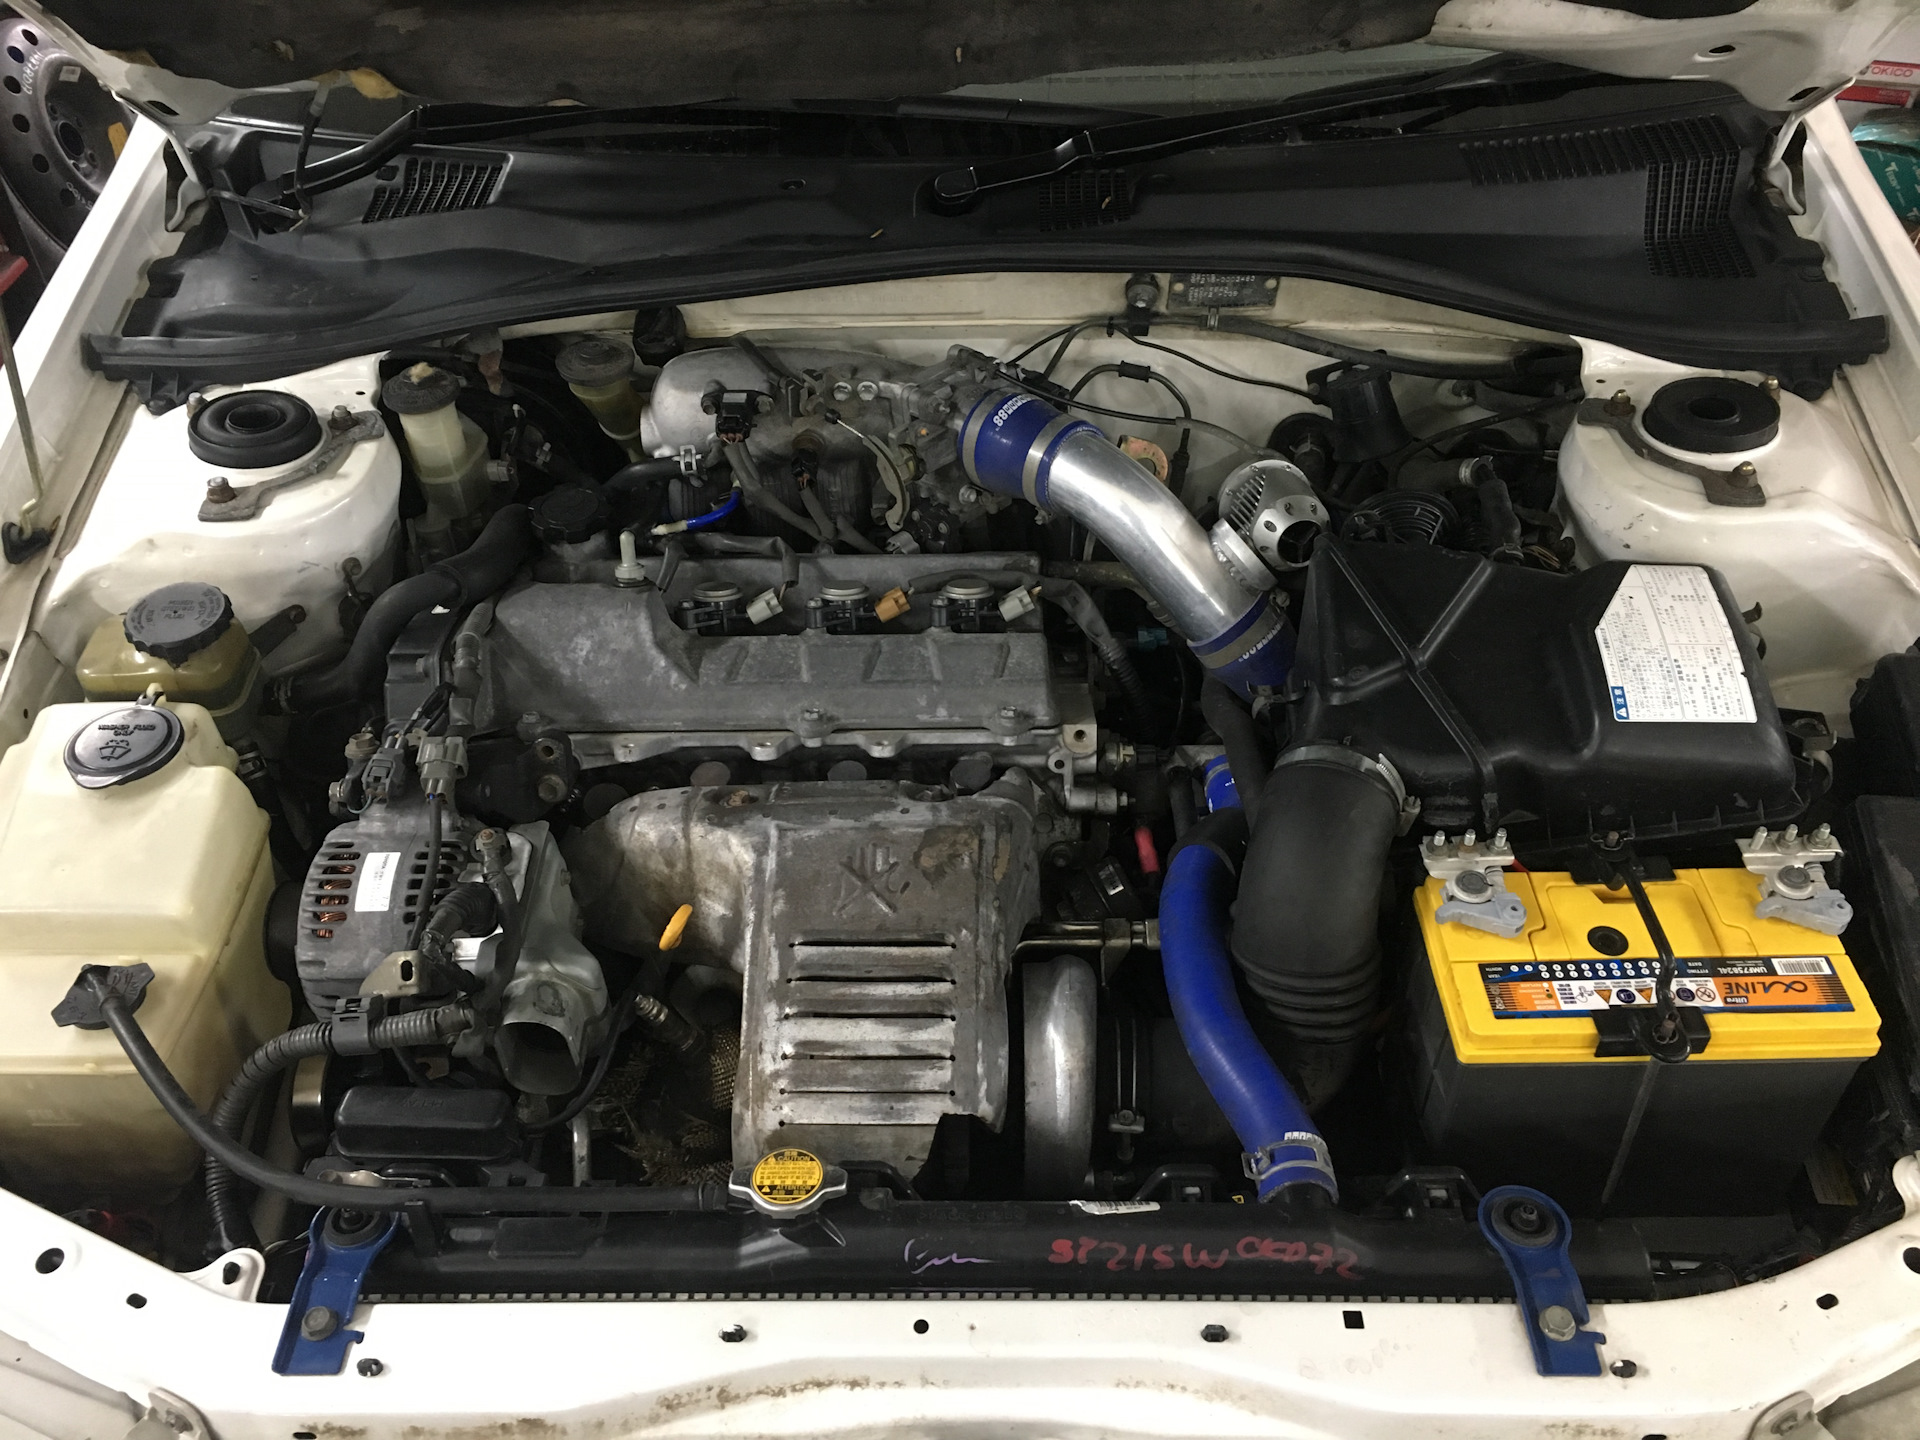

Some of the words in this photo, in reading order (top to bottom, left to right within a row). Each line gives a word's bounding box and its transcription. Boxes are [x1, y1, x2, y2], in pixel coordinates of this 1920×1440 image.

[1870, 65, 1914, 77] OKICO
[1613, 688, 1625, 706] 注意
[1716, 965, 1767, 974] UMF75B24L
